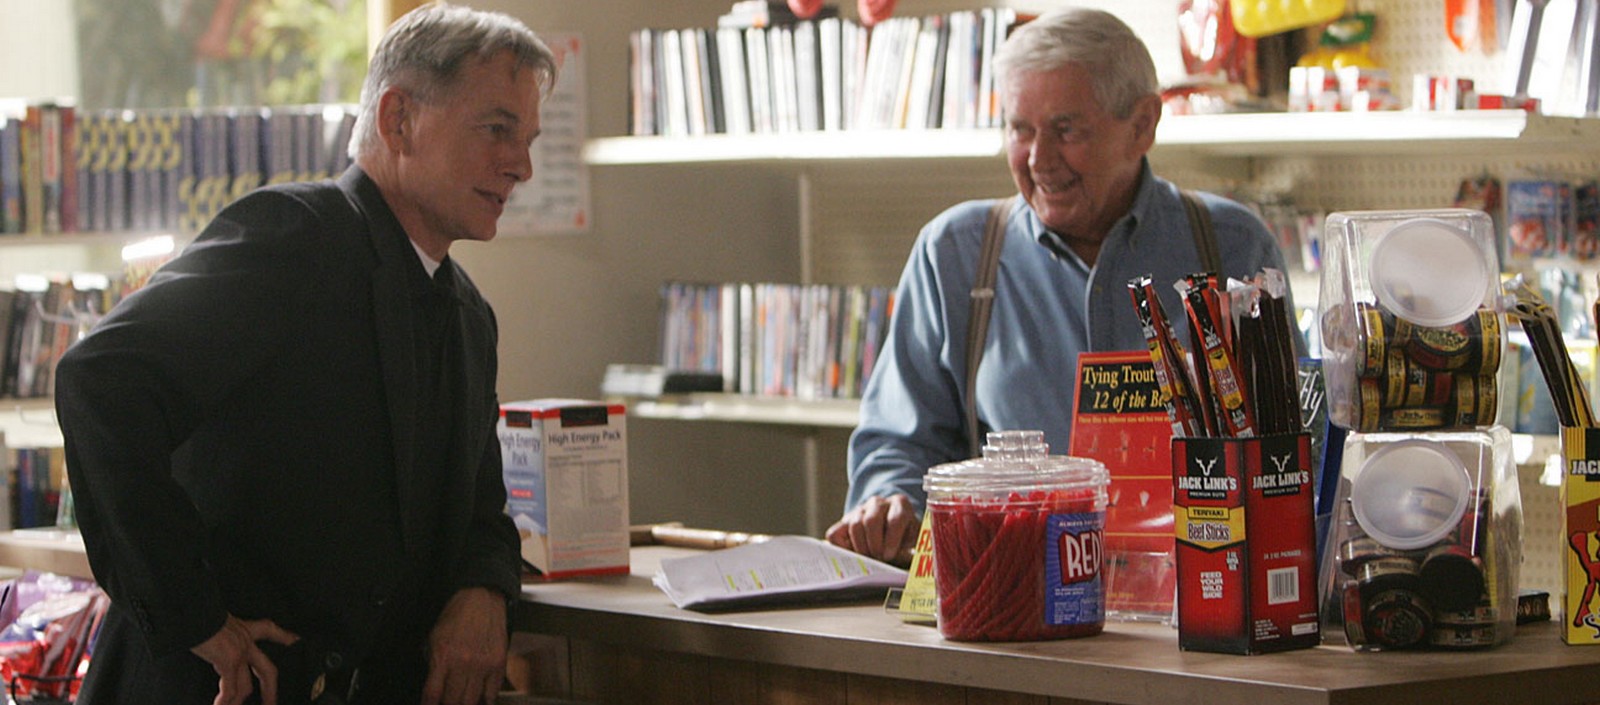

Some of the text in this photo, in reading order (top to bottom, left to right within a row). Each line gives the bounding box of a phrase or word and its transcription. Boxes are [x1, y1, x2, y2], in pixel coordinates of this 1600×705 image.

[1082, 366, 1119, 390] Tying
[1121, 365, 1155, 383] Trout
[1092, 391, 1110, 409] 12
[1112, 390, 1128, 413] of
[1128, 390, 1147, 408] the
[1298, 370, 1324, 427] Fly
[516, 434, 541, 453] Energy
[547, 434, 569, 448] High
[570, 431, 600, 446] Energy
[602, 429, 621, 442] Pack
[511, 451, 528, 466] Pack
[1571, 460, 1600, 475] JAC
[1178, 476, 1237, 491] JACK LINK'S
[1252, 470, 1309, 489] JACK LINK'S
[1193, 508, 1224, 517] TERIYAKI
[1187, 521, 1231, 541] Beef Sticks
[1064, 530, 1100, 579] RED
[1200, 571, 1222, 580] FEED
[1202, 591, 1223, 600] SIDE
